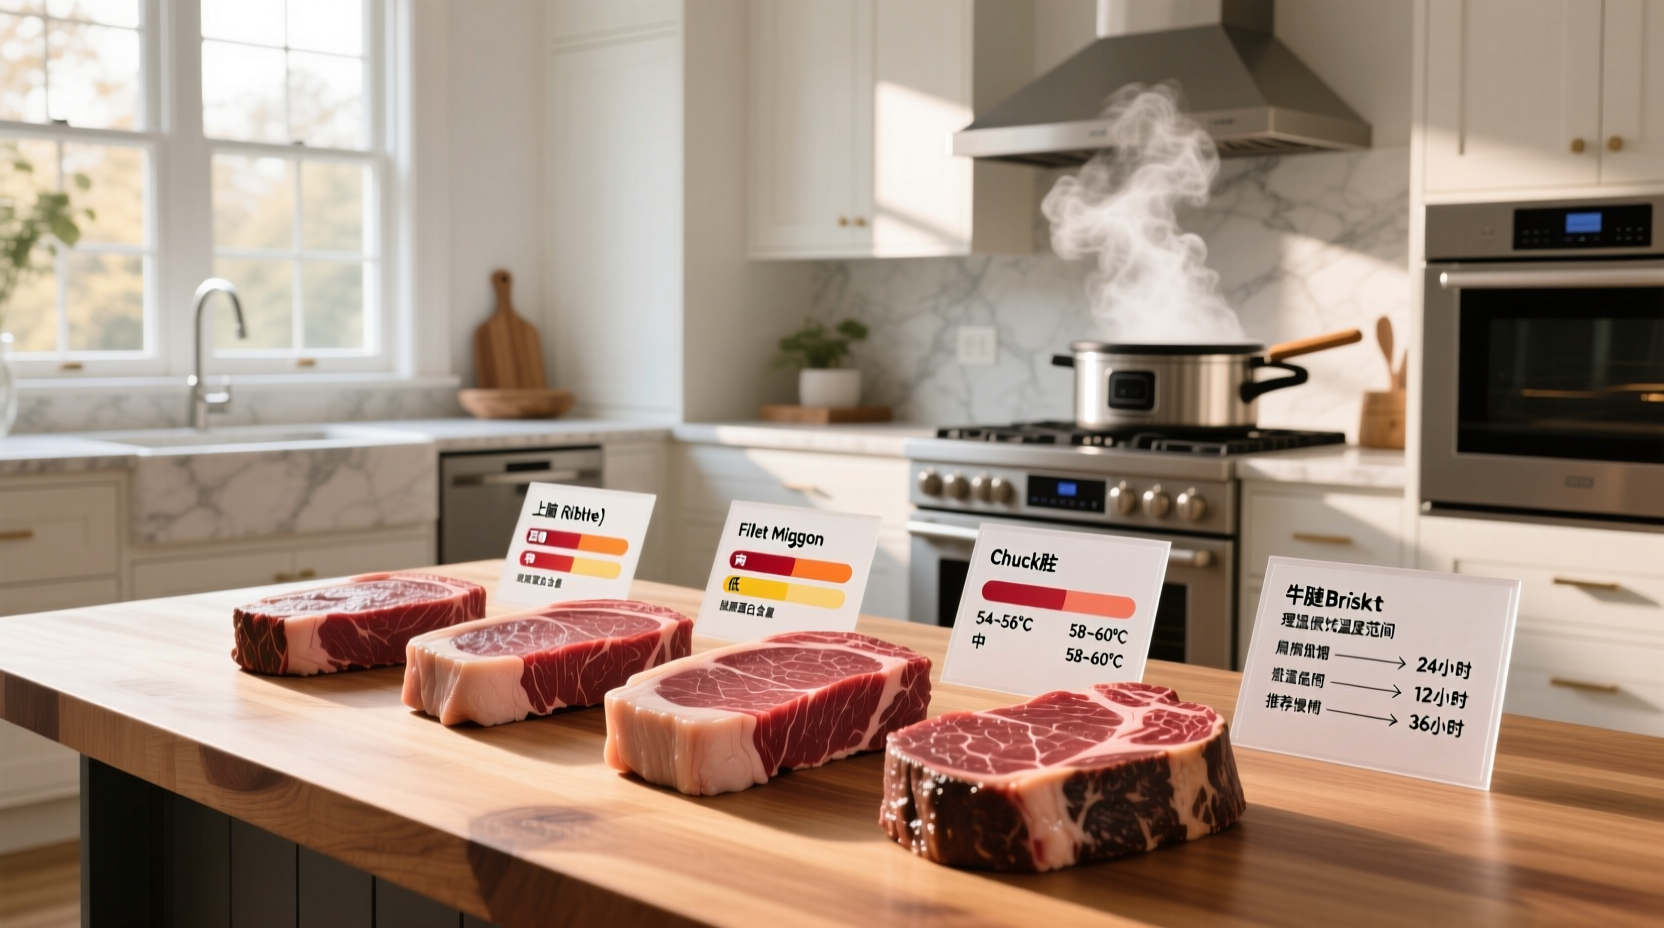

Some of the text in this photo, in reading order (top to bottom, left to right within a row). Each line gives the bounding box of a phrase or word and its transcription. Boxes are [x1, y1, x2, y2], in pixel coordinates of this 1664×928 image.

[738, 522, 768, 540] Filet
[971, 632, 986, 649] 中
[1416, 656, 1473, 680] 24小时
[1414, 686, 1470, 709] 12小时
[1408, 714, 1465, 738] 36小时
